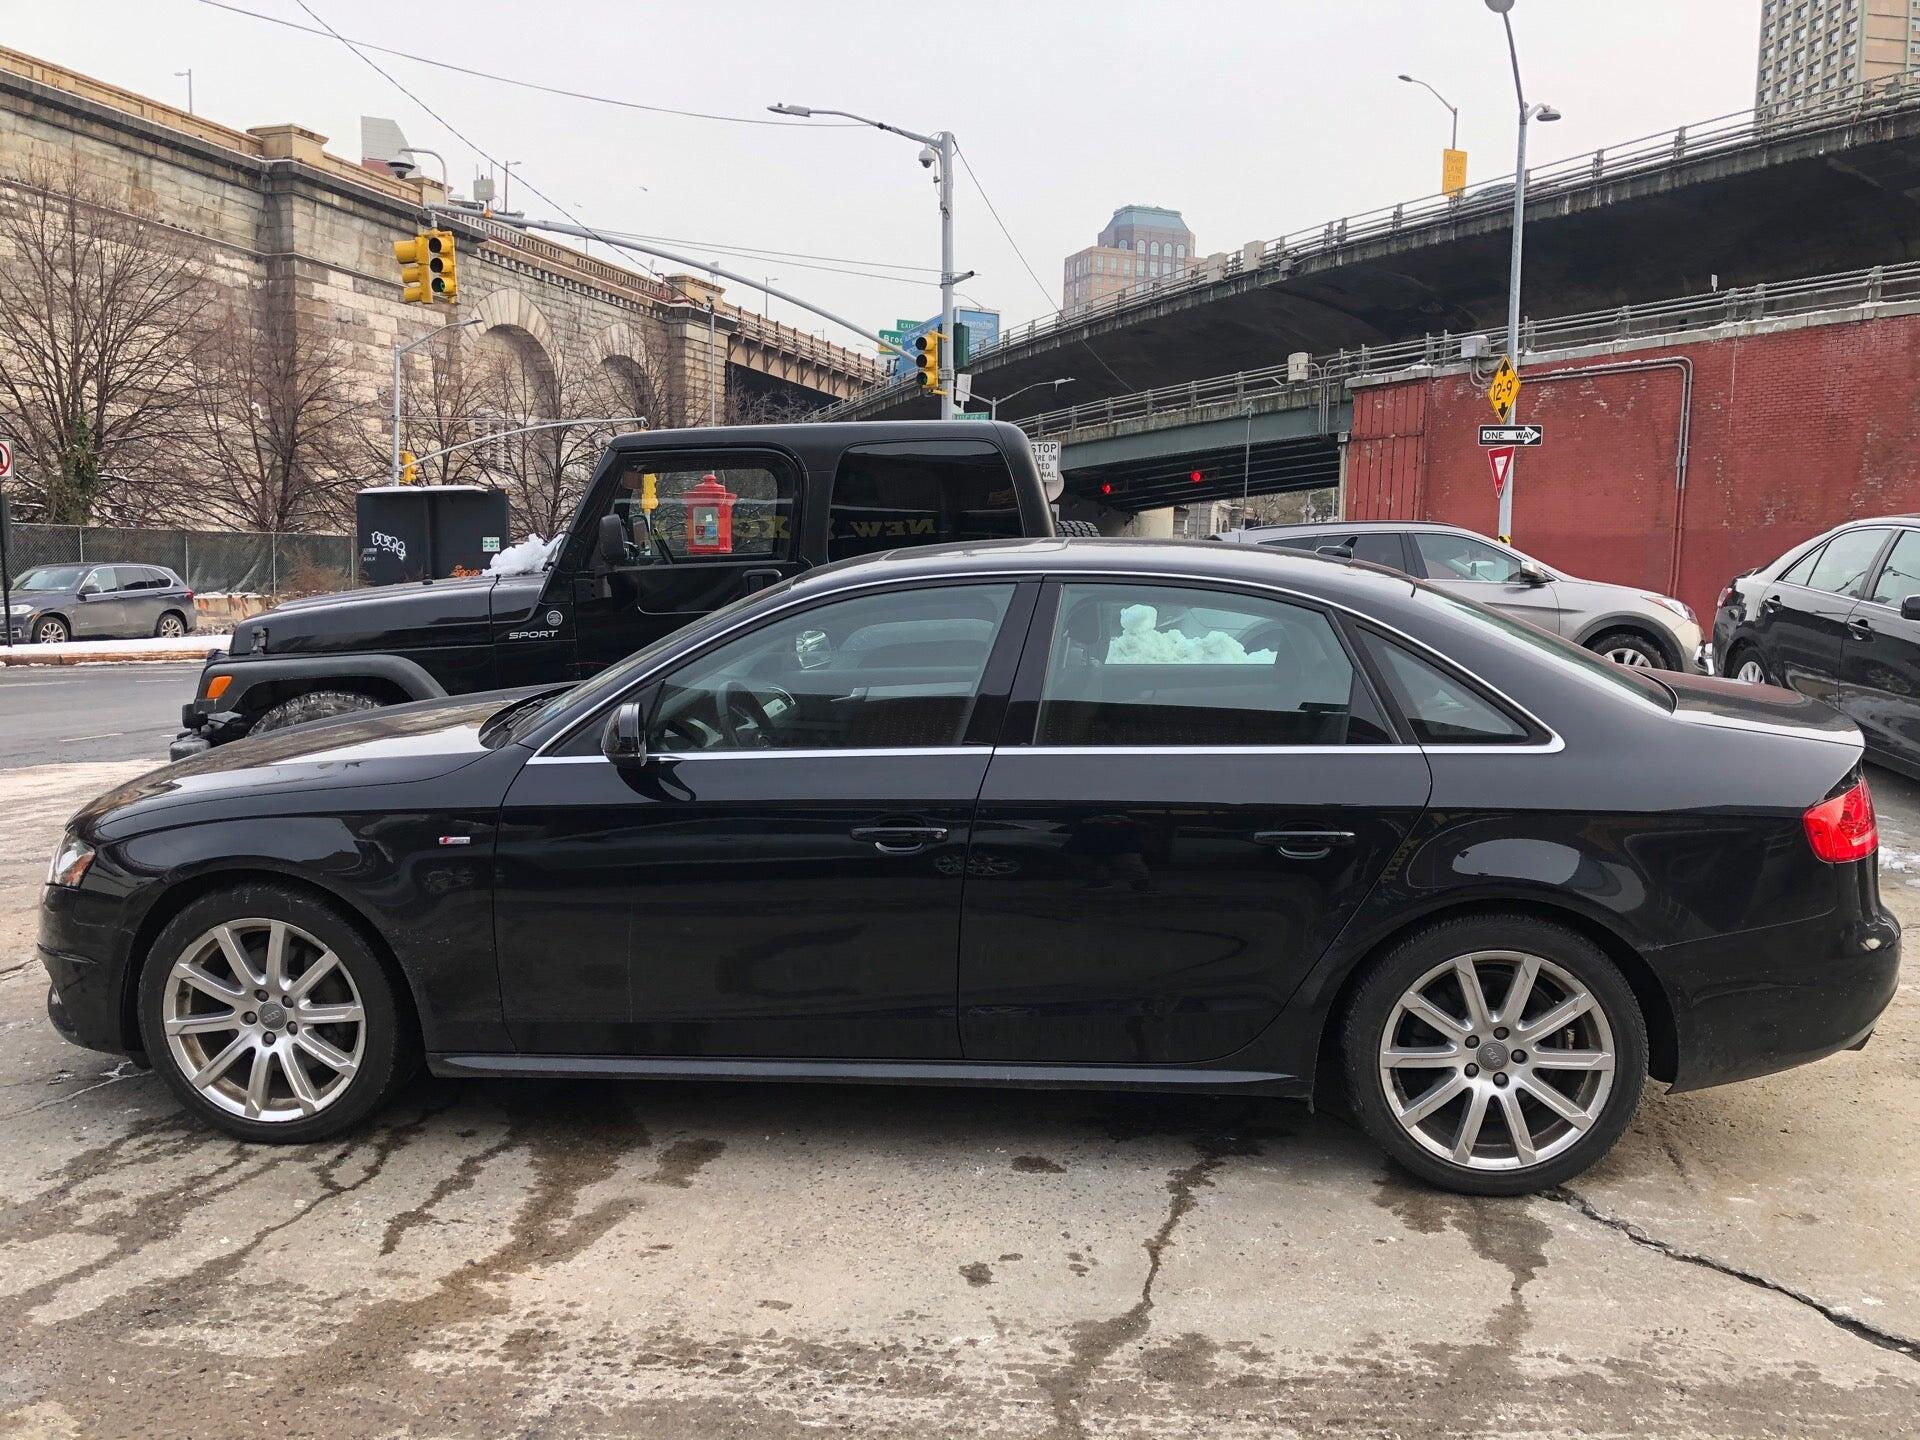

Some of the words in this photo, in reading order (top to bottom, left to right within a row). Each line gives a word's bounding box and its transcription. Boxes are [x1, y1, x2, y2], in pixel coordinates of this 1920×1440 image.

[1485, 431, 1505, 440] ONE
[1515, 431, 1535, 440] WAY
[1031, 443, 1057, 453] STOP
[509, 630, 559, 640] SPORT
